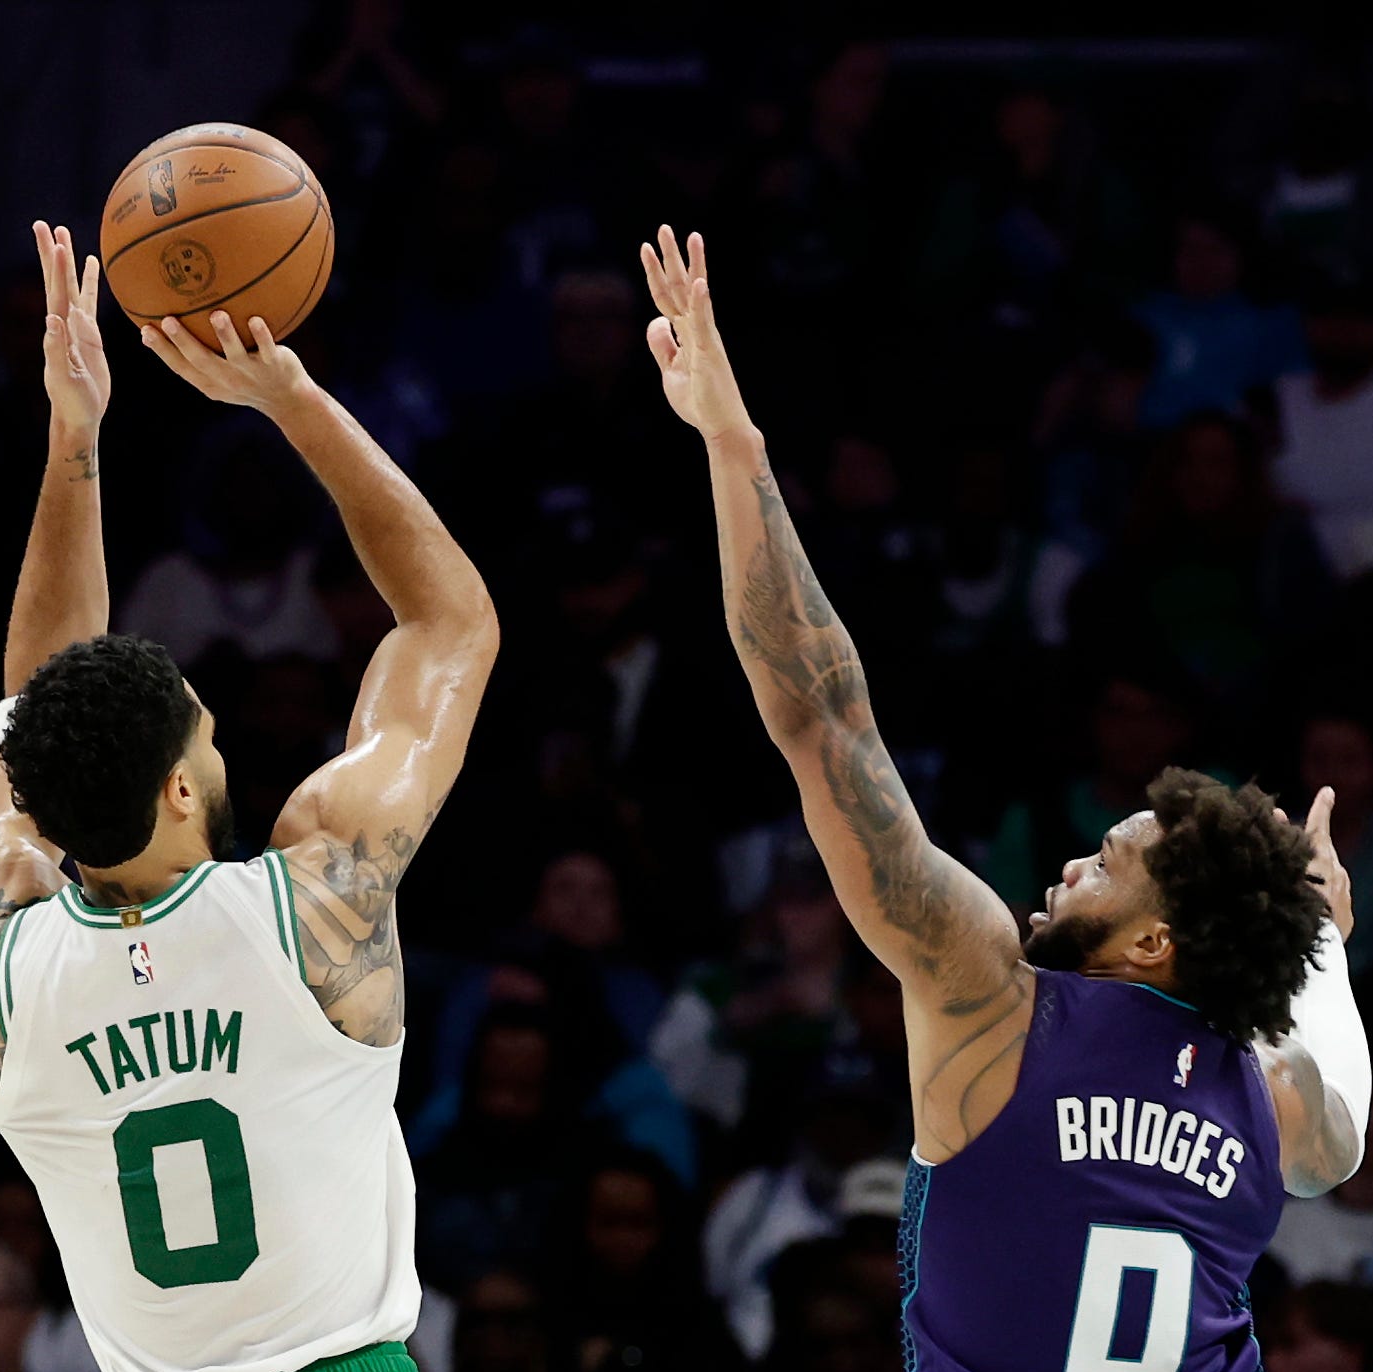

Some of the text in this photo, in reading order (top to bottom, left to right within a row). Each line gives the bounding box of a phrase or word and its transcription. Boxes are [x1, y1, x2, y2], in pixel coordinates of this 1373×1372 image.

[65, 1008, 243, 1096] TATUM
[113, 1098, 259, 1289] 0
[1056, 1096, 1244, 1199] BRIDGES
